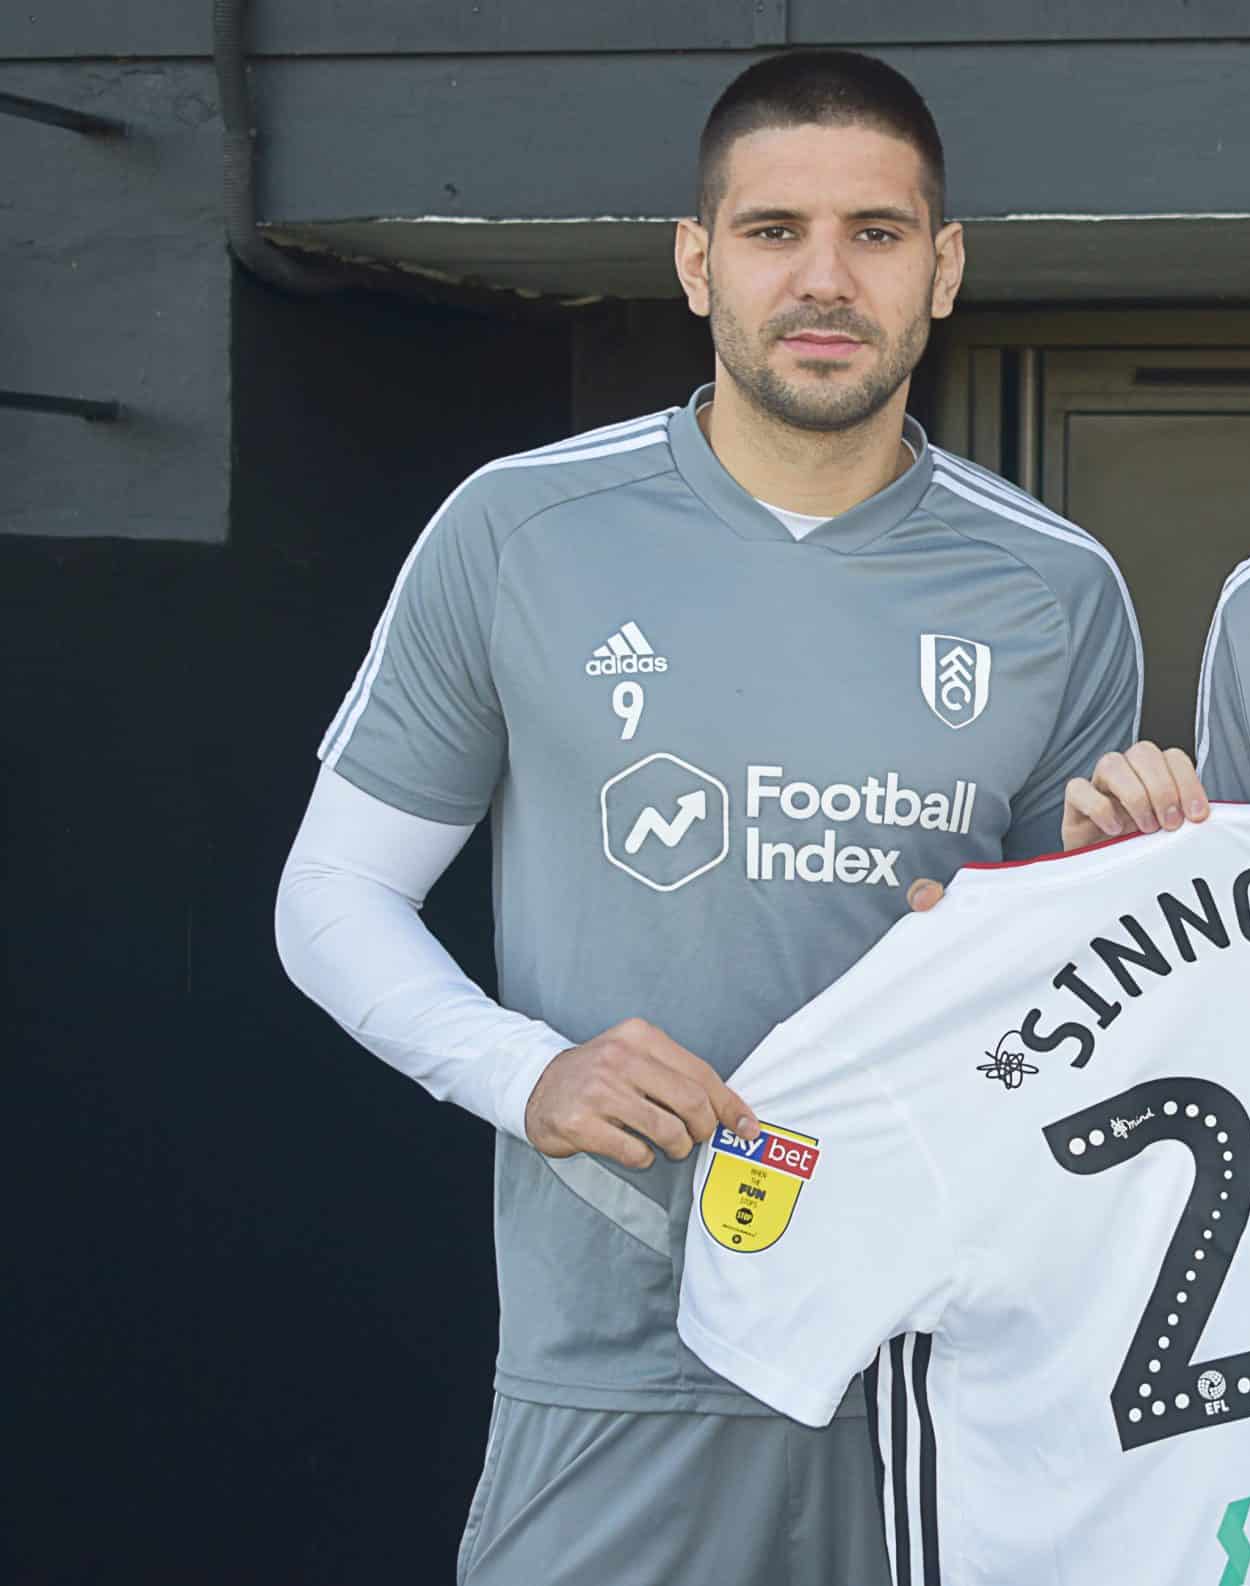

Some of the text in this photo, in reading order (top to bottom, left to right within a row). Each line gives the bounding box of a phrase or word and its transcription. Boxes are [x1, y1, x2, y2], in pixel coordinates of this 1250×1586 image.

[586, 654, 668, 675] adidas
[612, 681, 644, 739] 9
[746, 766, 977, 834] Football
[746, 827, 900, 887] Index
[768, 1138, 813, 1171] bet
[739, 1183, 766, 1201] FUN
[1204, 1399, 1230, 1415] EFL
